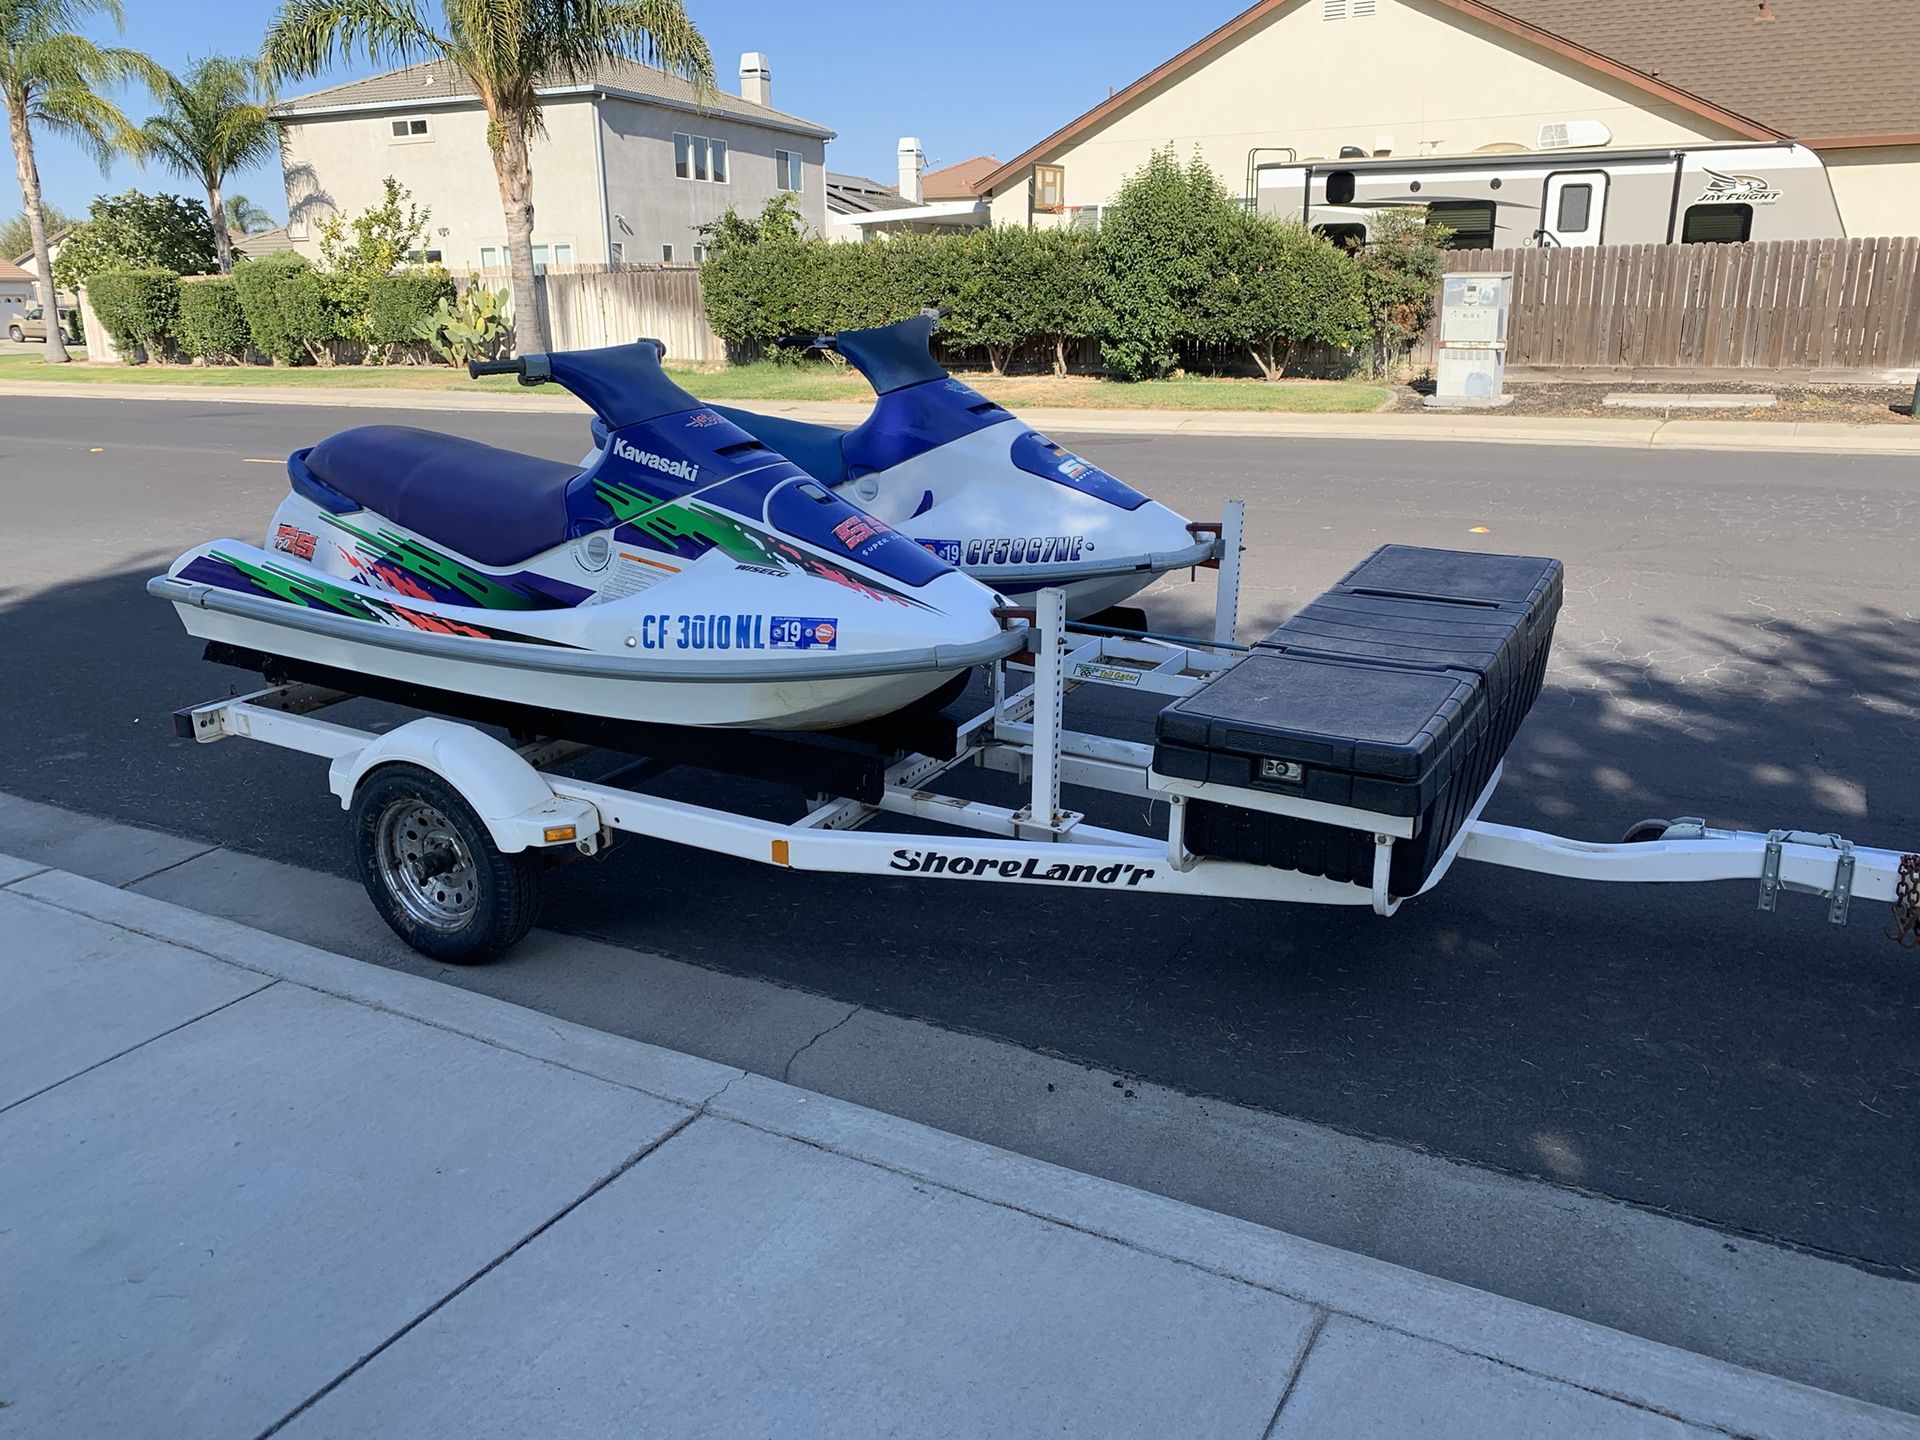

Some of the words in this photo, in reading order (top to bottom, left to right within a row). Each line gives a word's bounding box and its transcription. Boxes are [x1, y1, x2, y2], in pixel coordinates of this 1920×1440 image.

[1697, 193, 1725, 202] JAY
[1726, 191, 1782, 201] FLIGHT
[612, 437, 700, 482] Kawasaki
[862, 537, 890, 557] SUPER
[943, 544, 960, 561] 19
[965, 536, 1083, 566] CF5867NE
[642, 614, 670, 650] CF
[780, 620, 802, 642] 19
[889, 848, 1156, 887] ShoreLand'r
